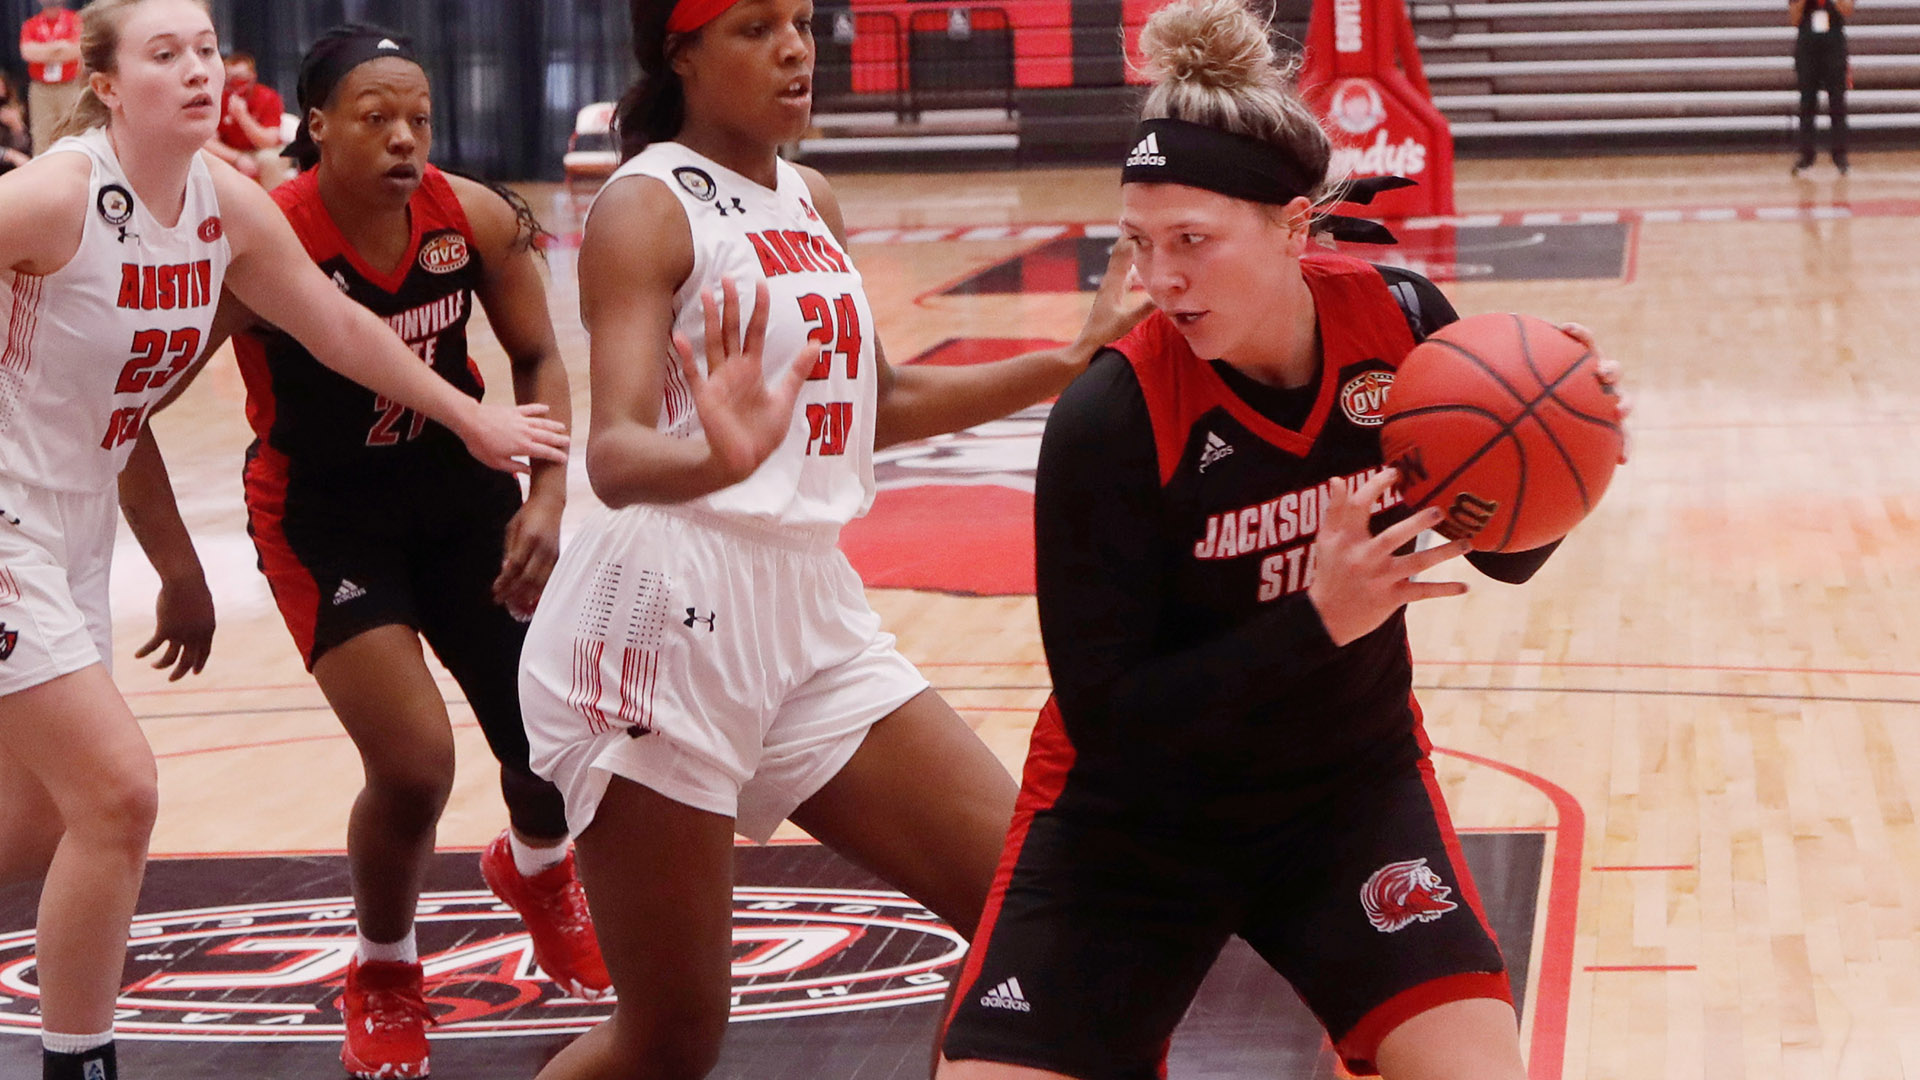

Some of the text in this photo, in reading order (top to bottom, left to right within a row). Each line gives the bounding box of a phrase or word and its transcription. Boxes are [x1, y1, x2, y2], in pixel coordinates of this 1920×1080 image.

[1125, 153, 1167, 167] adidas
[428, 243, 462, 266] OVC
[744, 229, 852, 278] AUSTIN
[116, 258, 212, 311] AUSTIN
[383, 288, 464, 342] ONVILLE
[795, 292, 862, 381] 24
[113, 326, 202, 395] 23
[1194, 464, 1406, 561] JACKSONL
[979, 994, 1032, 1012] adidas
